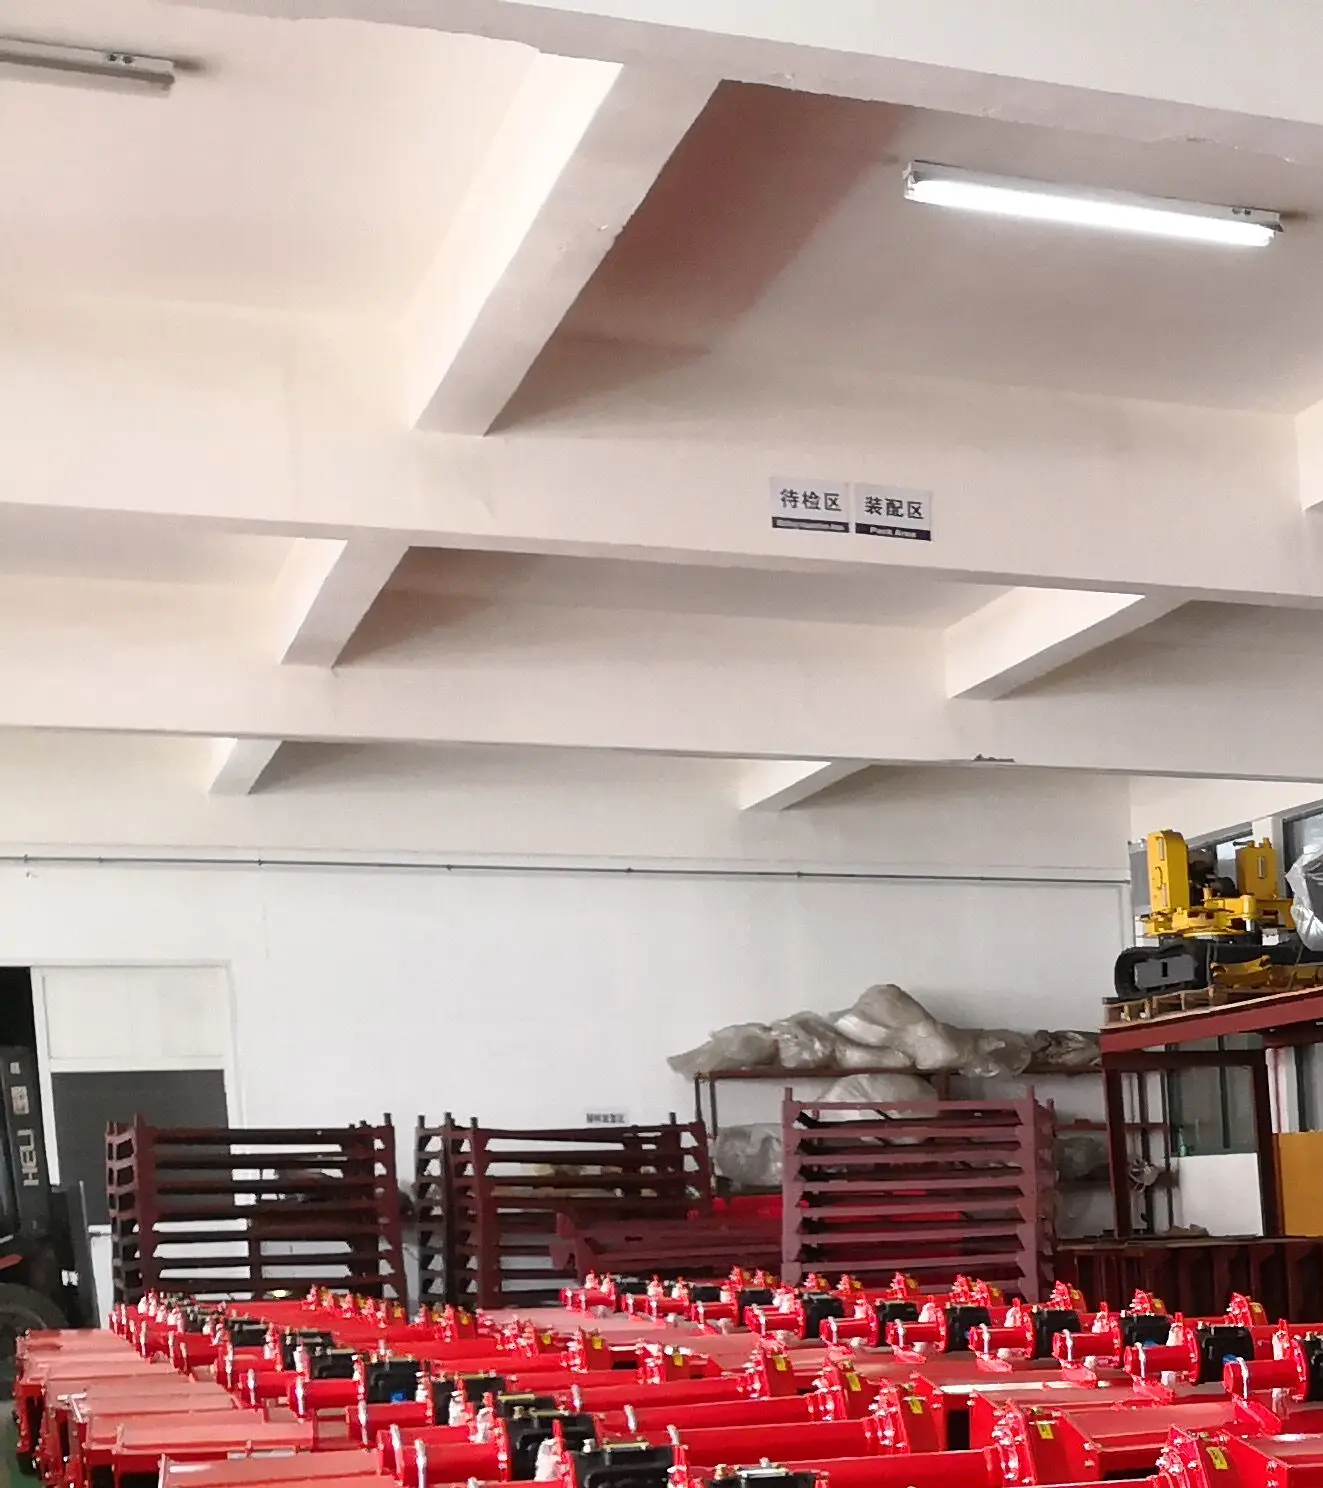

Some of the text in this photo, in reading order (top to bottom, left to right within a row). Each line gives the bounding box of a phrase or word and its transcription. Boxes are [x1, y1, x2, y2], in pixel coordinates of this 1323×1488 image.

[780, 488, 842, 511] 待检区
[864, 496, 924, 519] 装配区
